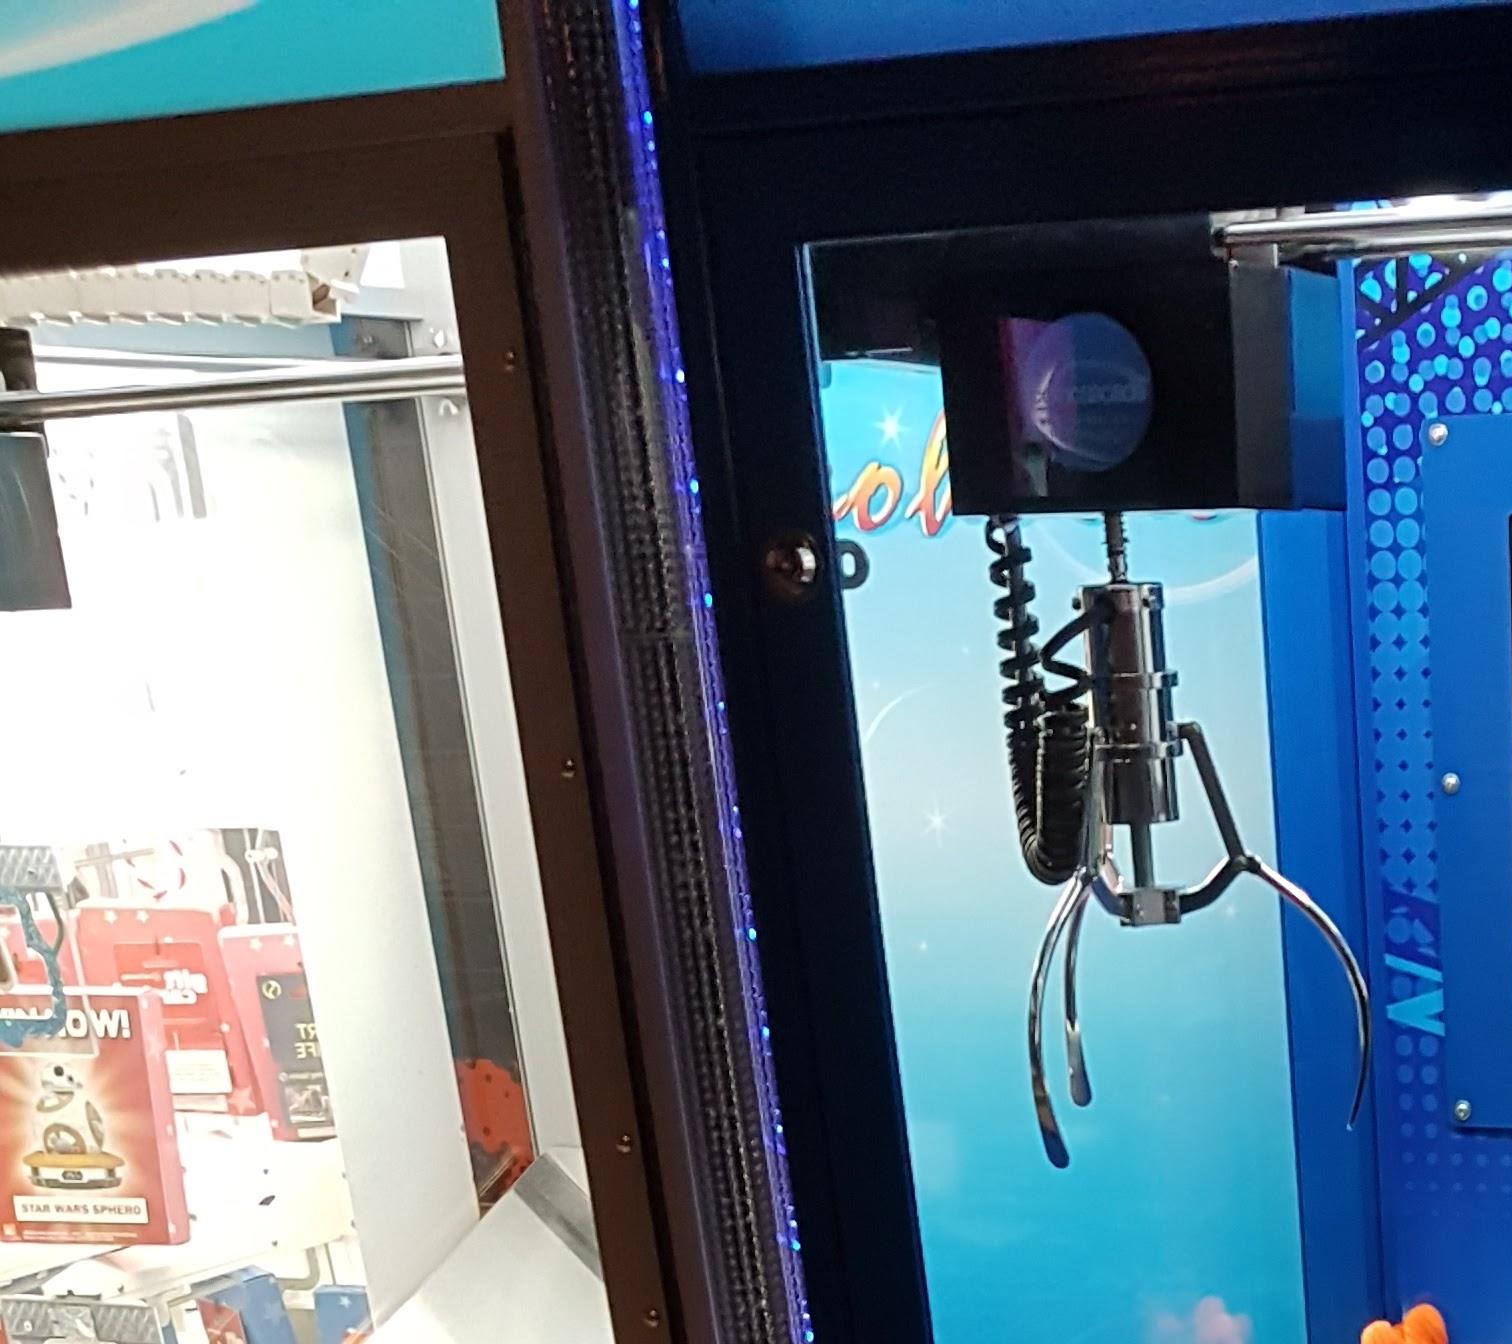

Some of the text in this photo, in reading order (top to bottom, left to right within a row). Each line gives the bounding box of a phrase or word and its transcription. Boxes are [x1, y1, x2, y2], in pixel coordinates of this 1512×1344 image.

[44, 1008, 131, 1039] OW!
[22, 1203, 141, 1216] STAR WARS SPHERO
